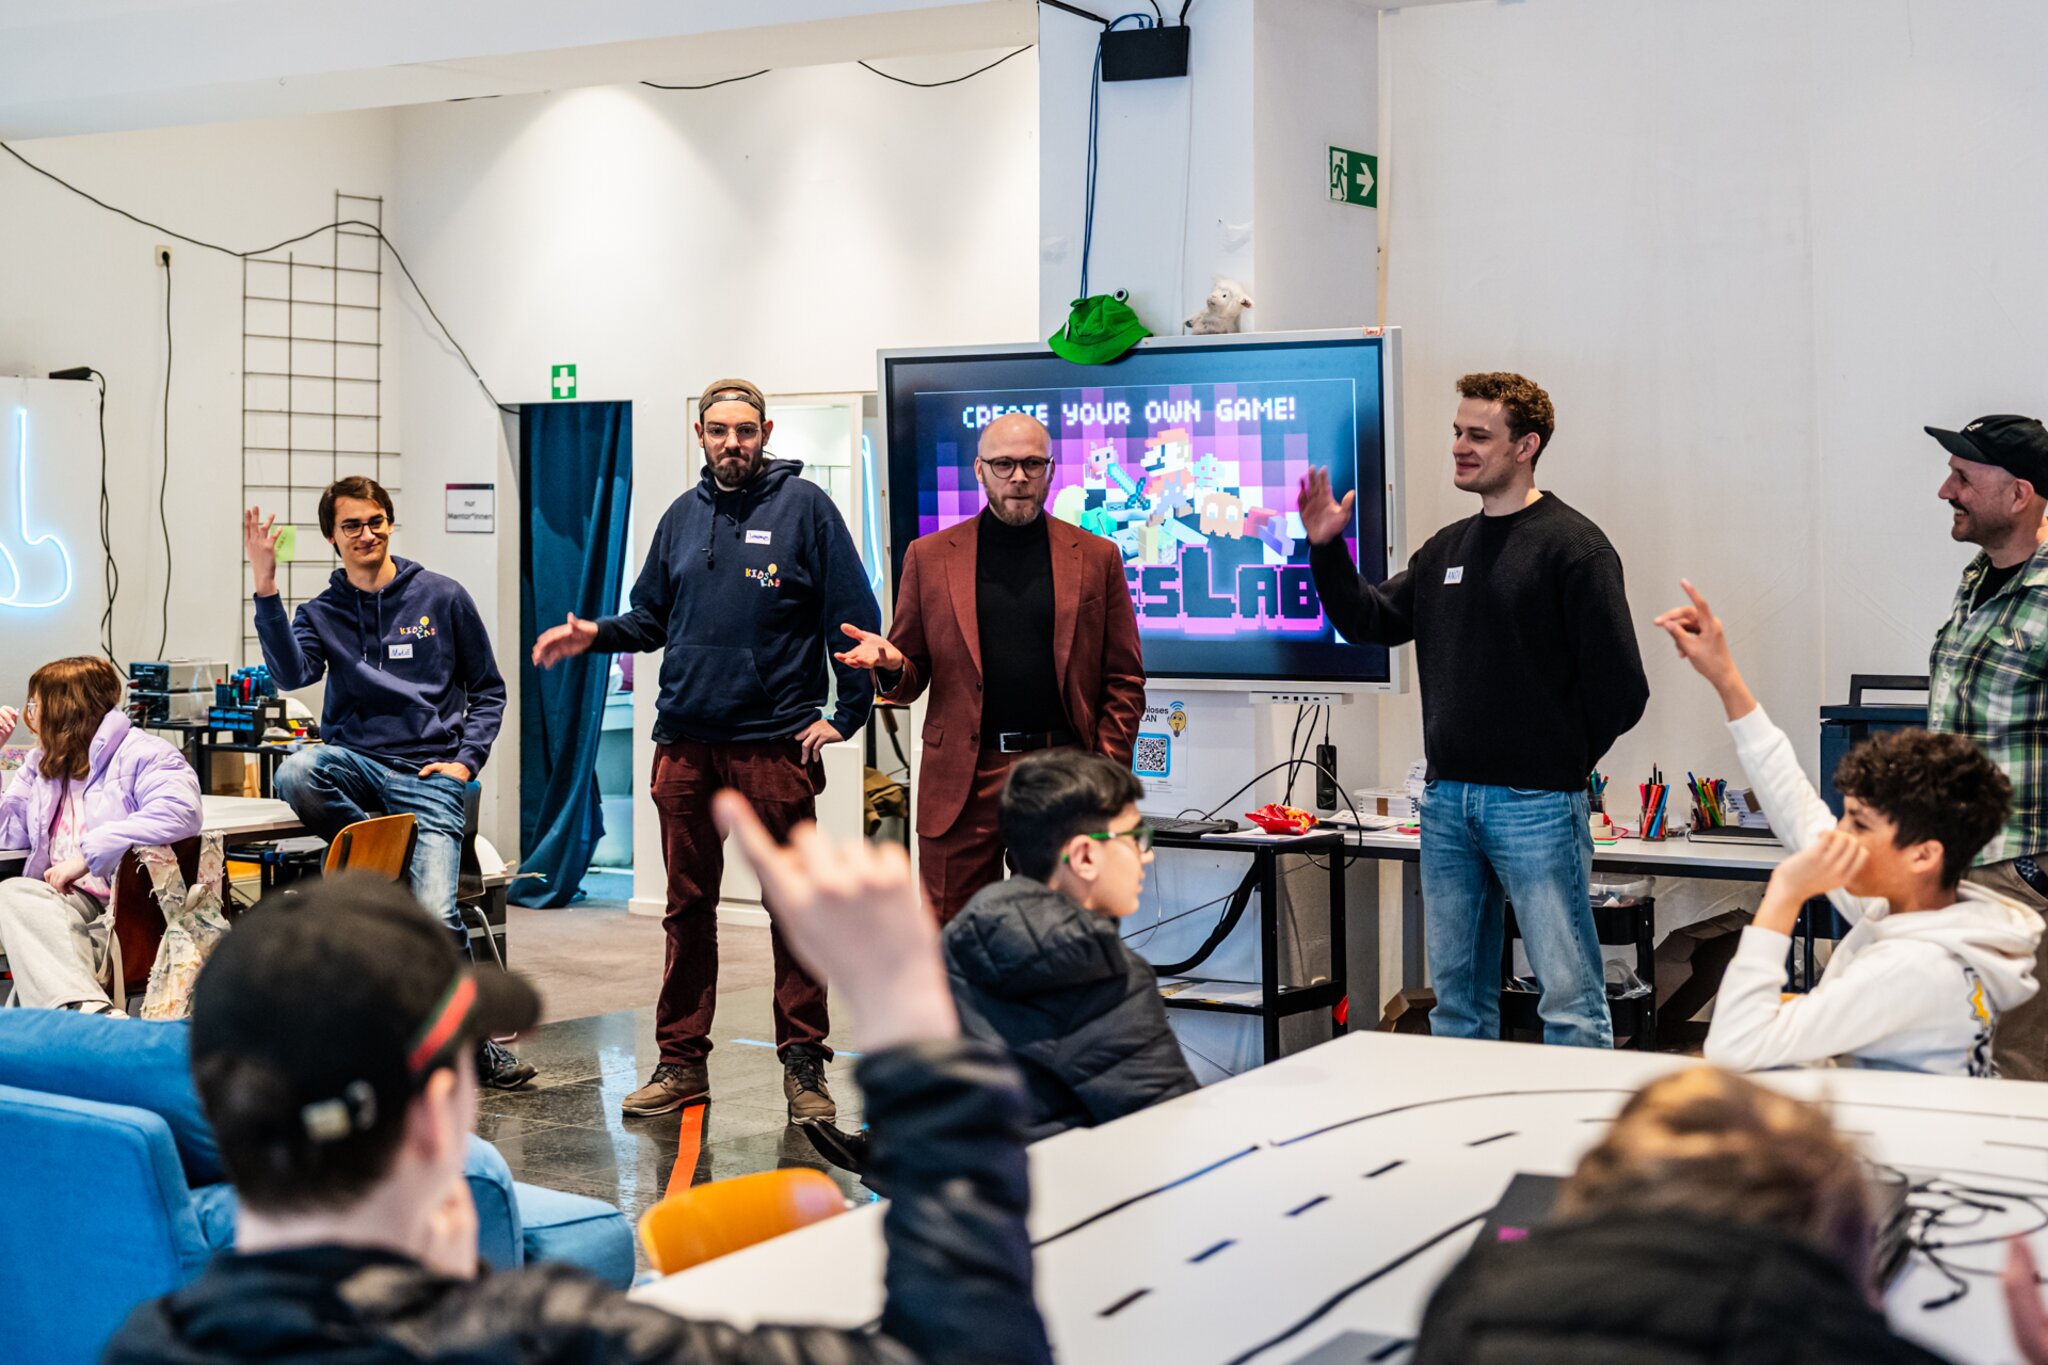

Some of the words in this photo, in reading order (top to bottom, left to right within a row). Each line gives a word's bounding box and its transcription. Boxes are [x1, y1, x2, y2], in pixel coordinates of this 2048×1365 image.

[1062, 402, 1130, 426] YOUR
[1145, 399, 1200, 424] OWN
[1215, 396, 1296, 422] GAME!
